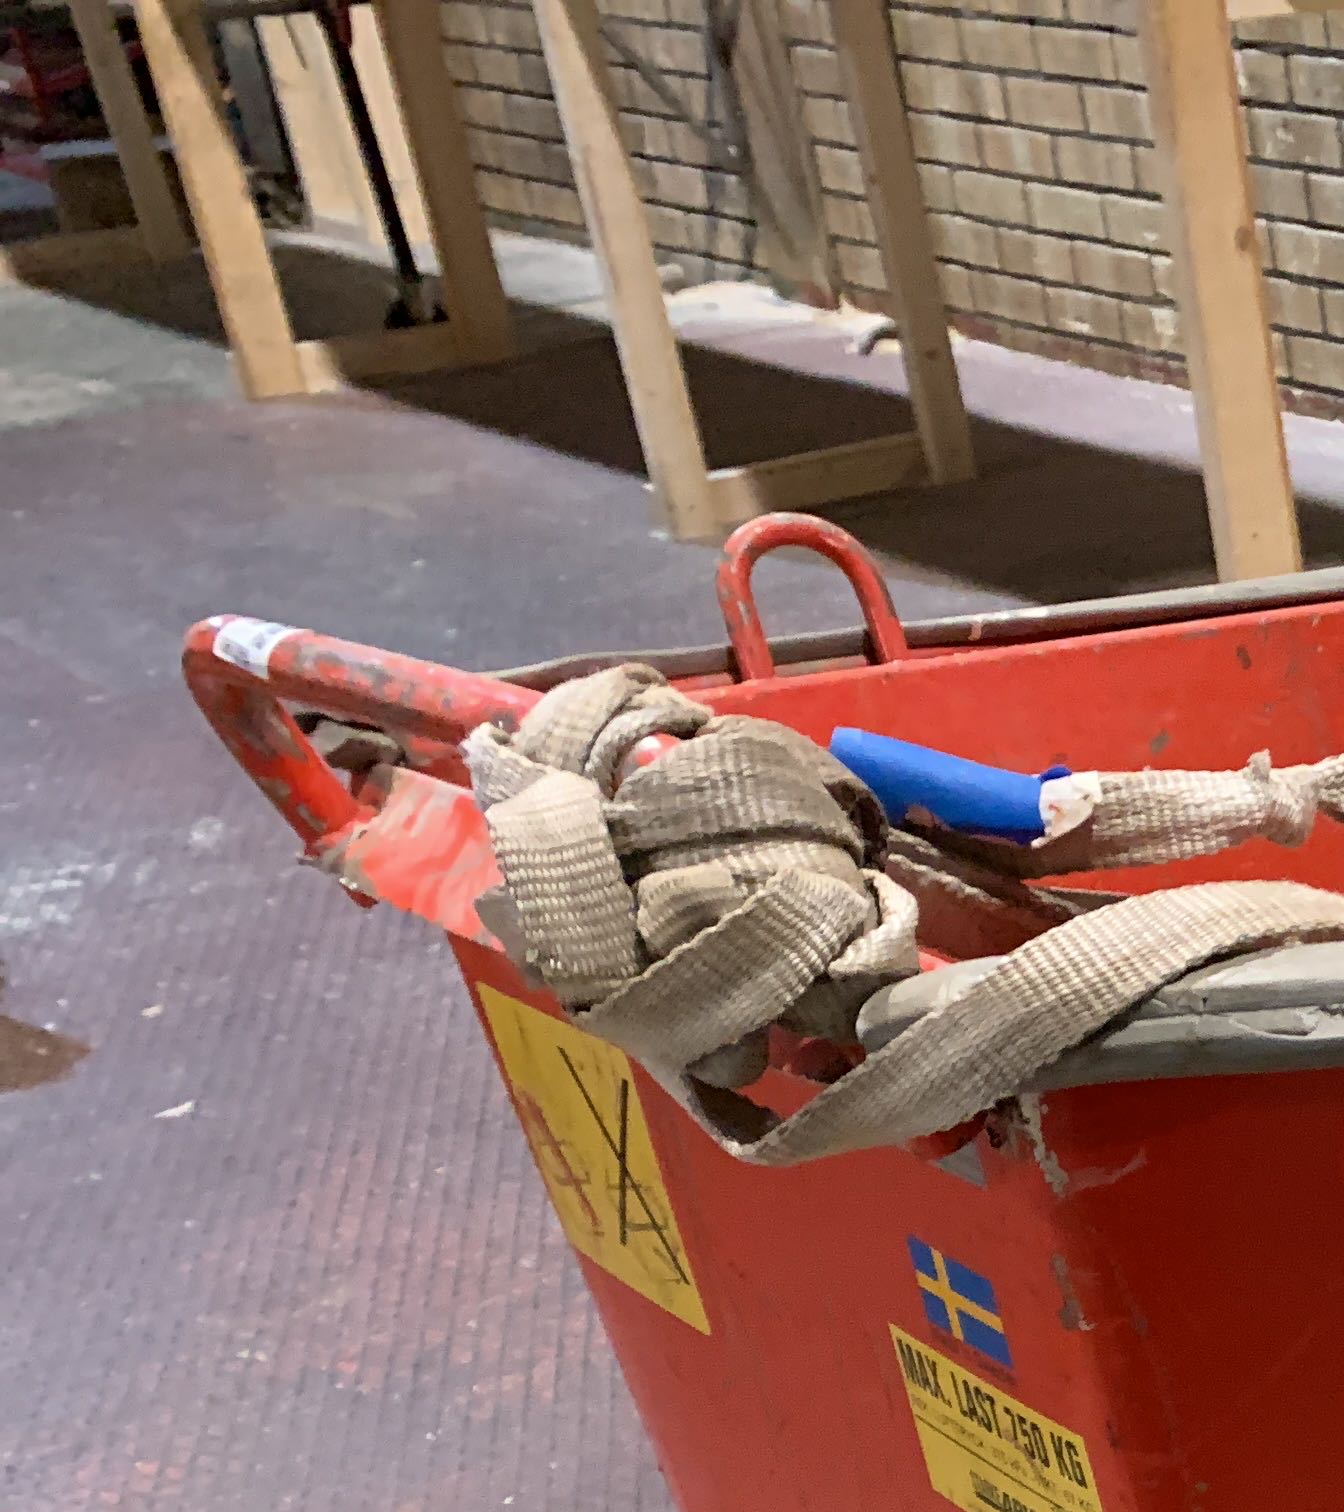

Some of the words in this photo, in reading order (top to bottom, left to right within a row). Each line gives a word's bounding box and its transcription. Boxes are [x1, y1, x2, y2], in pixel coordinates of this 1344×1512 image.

[896, 1338, 952, 1409] MAX.
[951, 1370, 1002, 1439] LAST
[1003, 1405, 1050, 1468] 750
[1050, 1431, 1088, 1489] KG
